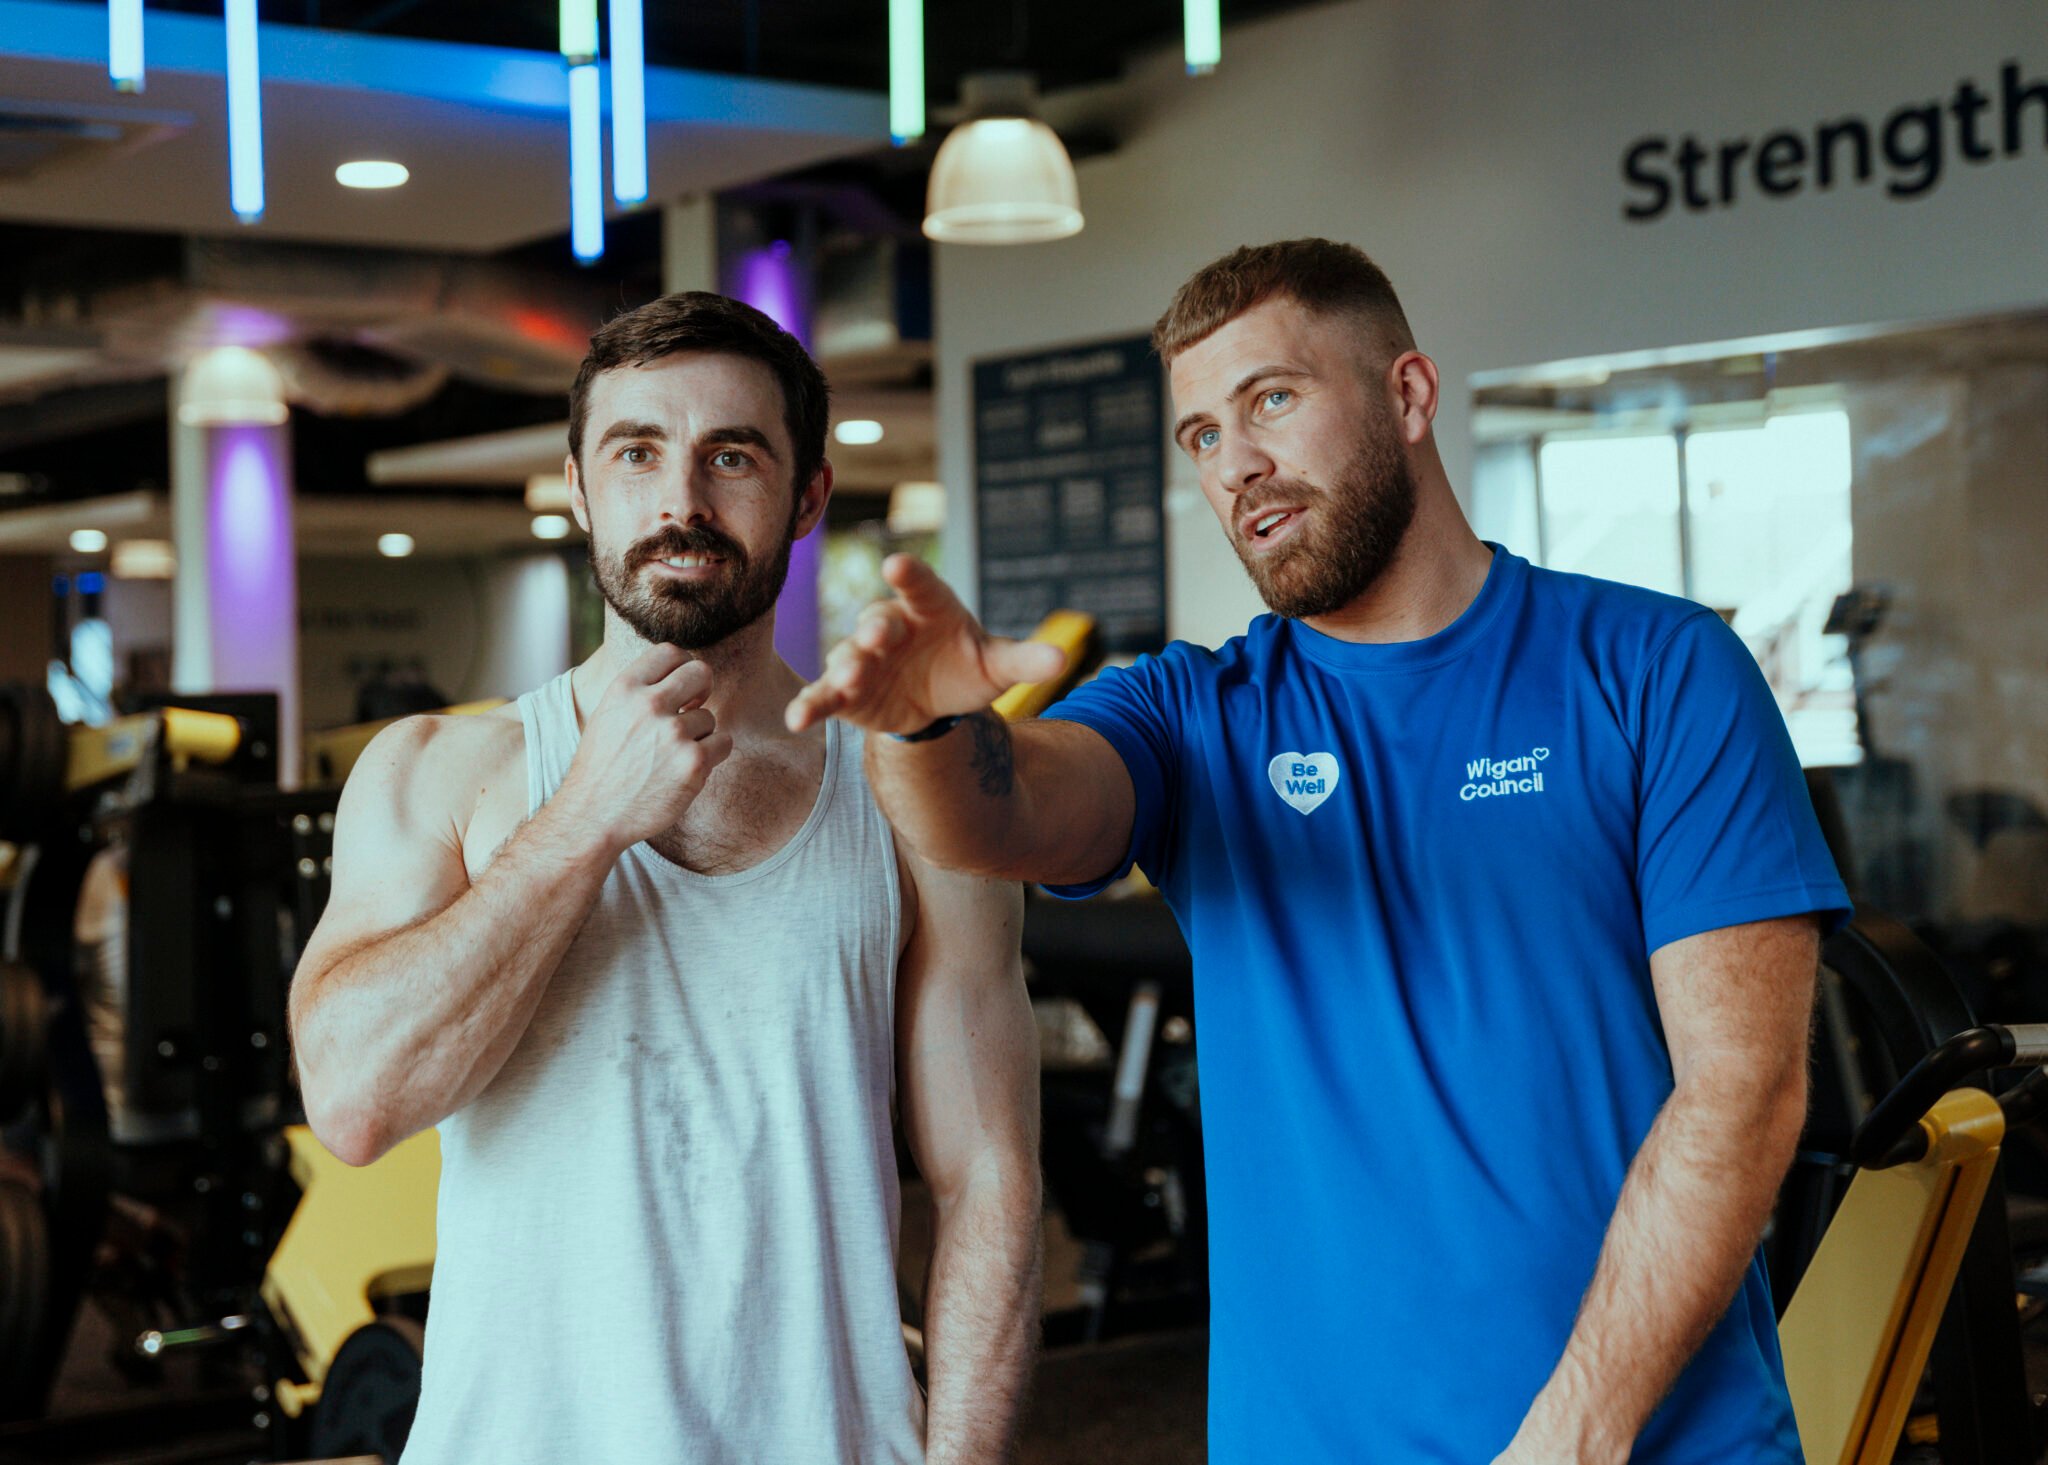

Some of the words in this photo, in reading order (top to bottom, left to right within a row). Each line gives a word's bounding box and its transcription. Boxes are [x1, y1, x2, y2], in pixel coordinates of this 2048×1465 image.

[1622, 60, 2048, 222] Strength
[1291, 762, 1318, 777] Be
[1466, 756, 1537, 780] Wigan
[1285, 779, 1325, 795] Well
[1459, 772, 1544, 801] Council
